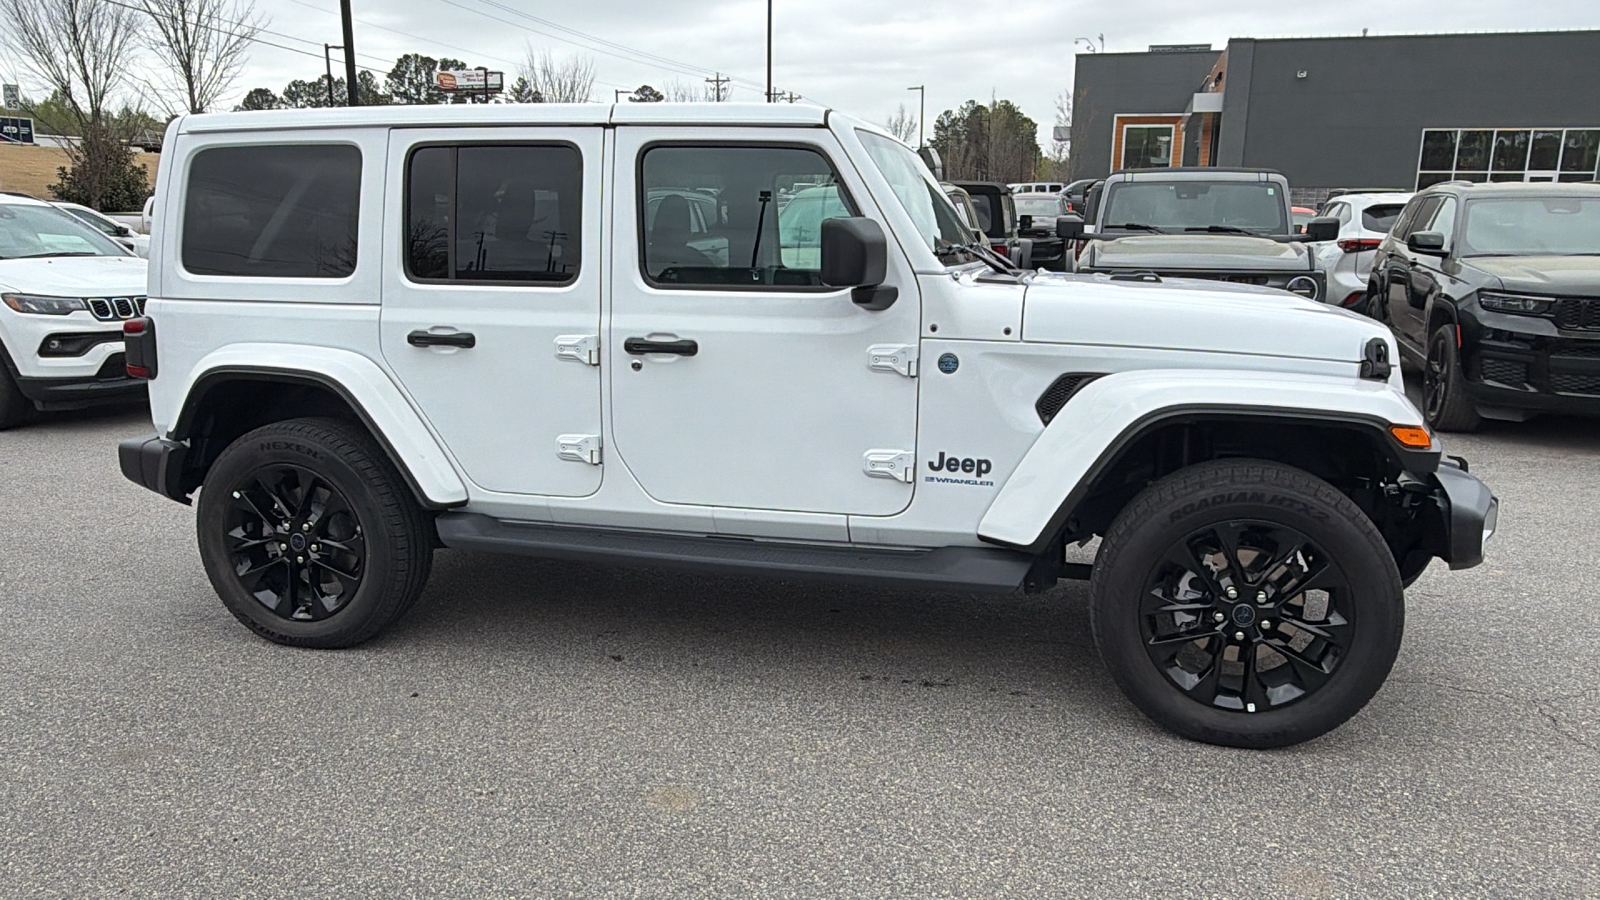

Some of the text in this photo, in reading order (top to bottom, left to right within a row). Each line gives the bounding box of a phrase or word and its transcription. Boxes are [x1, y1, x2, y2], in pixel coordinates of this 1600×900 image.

[7, 100, 18, 108] 65
[260, 441, 318, 459] NEXEN
[928, 451, 992, 477] Jeep
[936, 477, 994, 486] WRANGLER
[1169, 492, 1265, 523] ROADIAN
